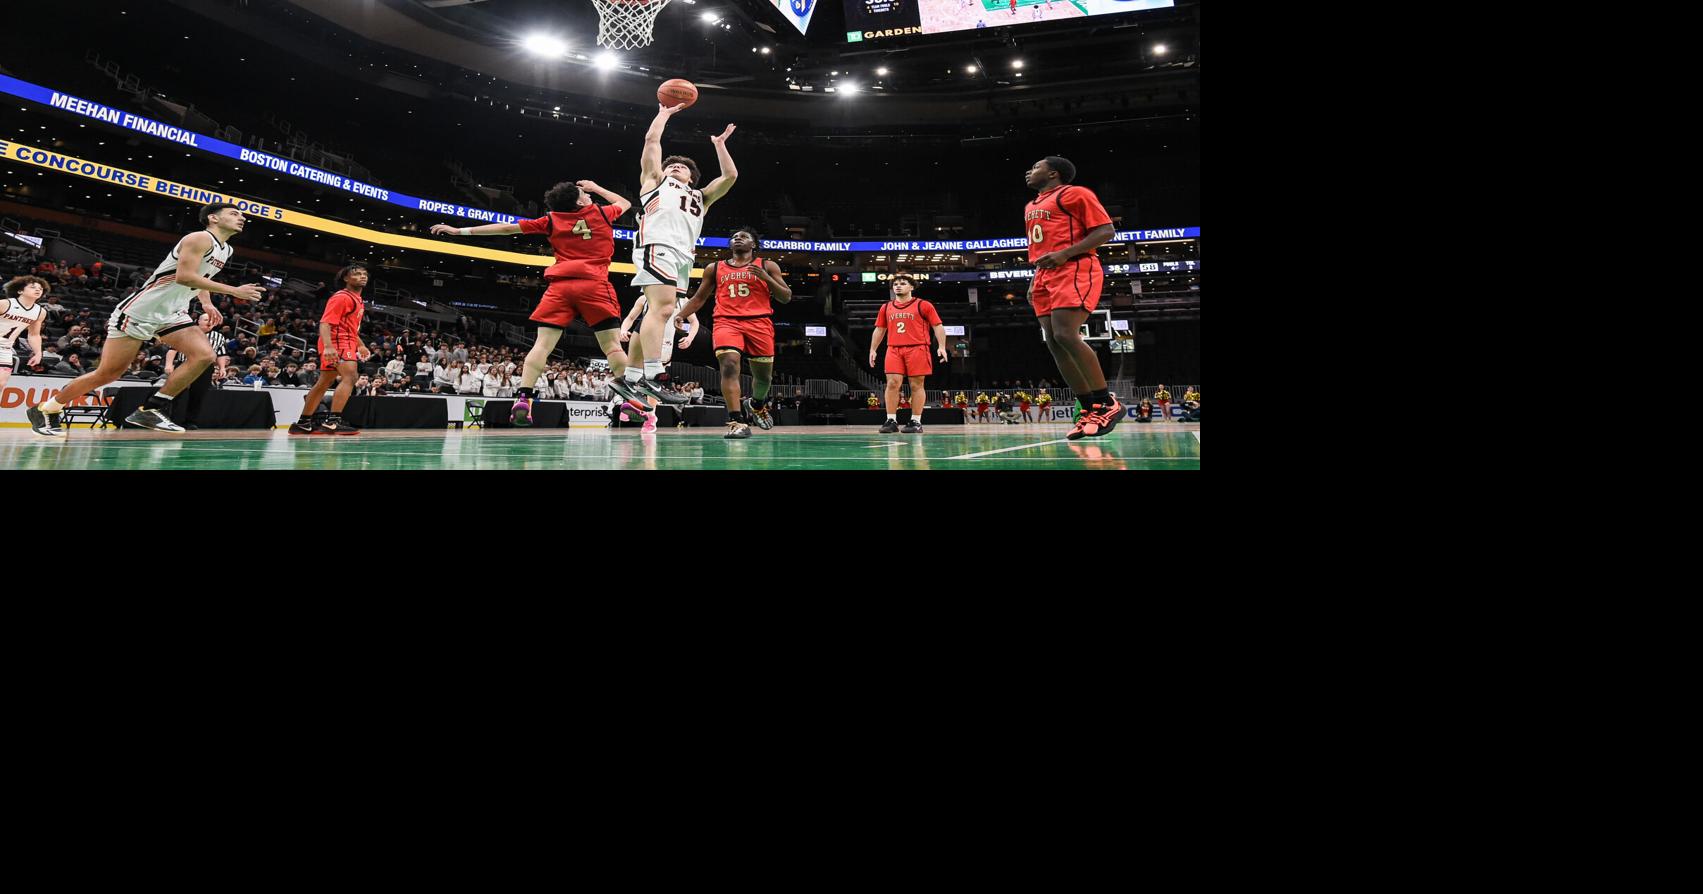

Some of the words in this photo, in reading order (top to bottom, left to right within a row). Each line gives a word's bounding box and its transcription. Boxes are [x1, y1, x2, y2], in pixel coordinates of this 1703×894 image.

[864, 26, 922, 39] GARDEN
[50, 92, 120, 125] MEEHAN
[123, 114, 198, 147] FINANCIAL
[240, 148, 288, 173] BOSTON
[290, 163, 341, 188] CATERING
[343, 179, 351, 191] &
[353, 182, 389, 201] EVENTS
[16, 147, 149, 189] CONCOURSE
[155, 181, 222, 204] BEHIND
[274, 209, 283, 220] 5
[419, 199, 454, 215] ROPES
[456, 206, 465, 217] &
[467, 208, 495, 222] GRAY
[496, 213, 515, 225] LLP
[680, 195, 702, 217] 15
[572, 219, 592, 240] 4
[1144, 228, 1185, 240] FAMILY
[763, 240, 811, 250] SCARBRO
[814, 242, 851, 251] FAMILY
[881, 242, 909, 251] JOHN
[911, 242, 920, 250] &
[922, 241, 963, 250] JEANNE
[966, 238, 1028, 249] GALLAGHER
[990, 269, 1036, 279] BEVERL
[728, 283, 750, 298] 15
[896, 321, 906, 334] 2
